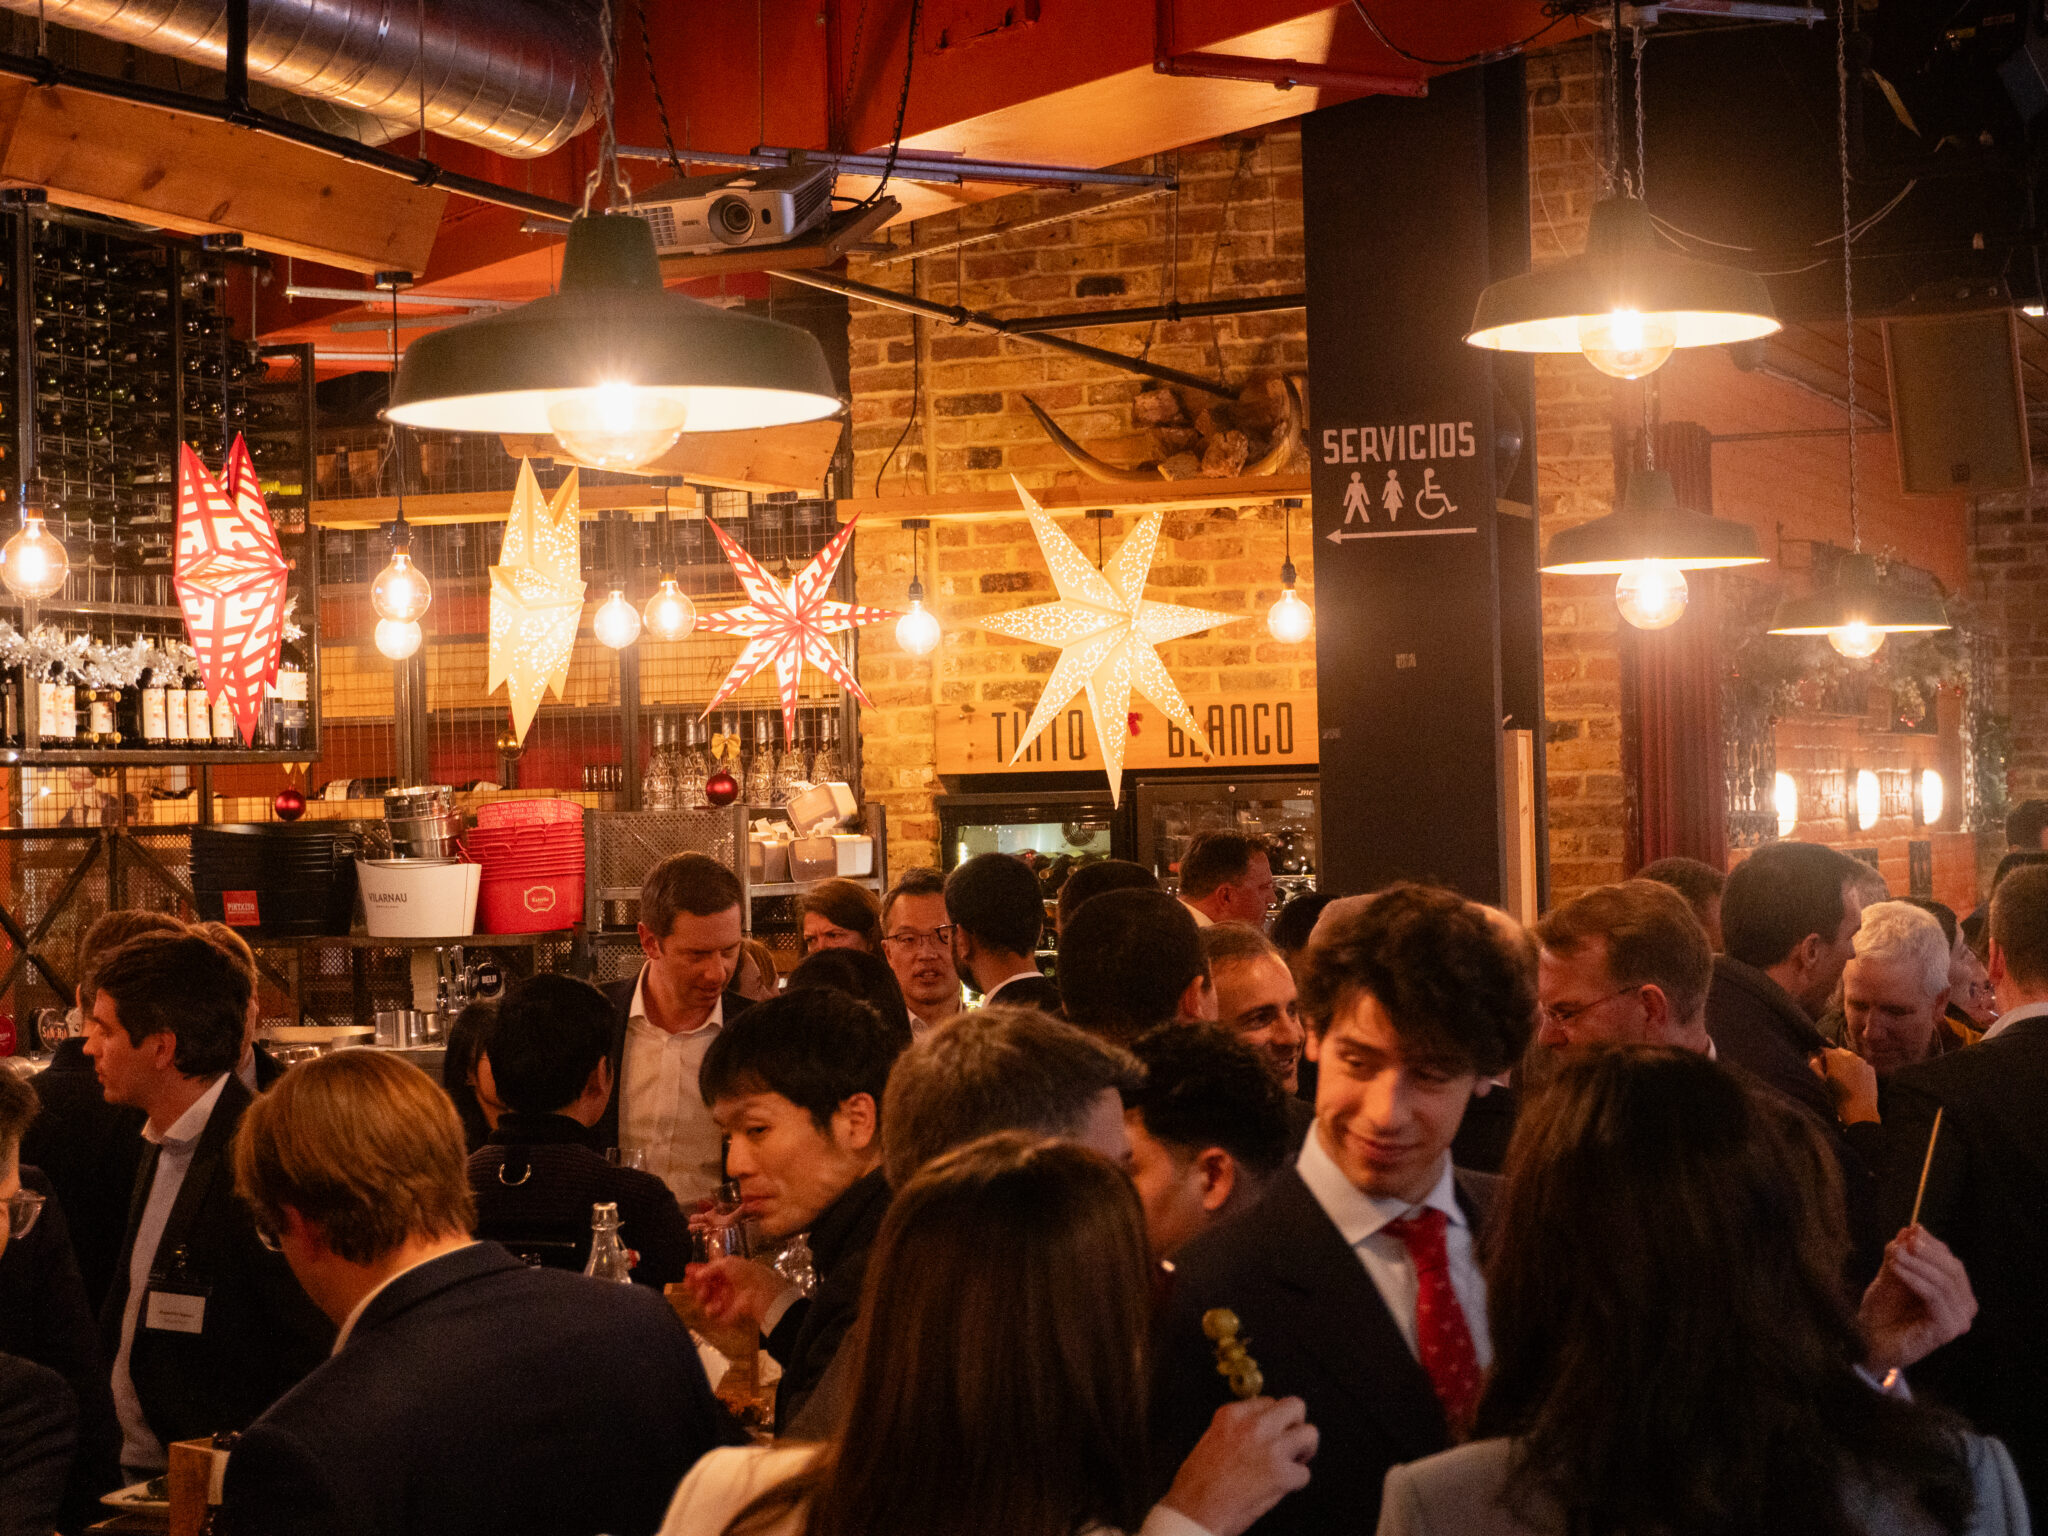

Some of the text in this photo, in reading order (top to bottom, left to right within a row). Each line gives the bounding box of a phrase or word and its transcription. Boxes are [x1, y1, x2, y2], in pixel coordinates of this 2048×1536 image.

[1323, 422, 1475, 464] SERVICIOS
[1168, 702, 1294, 757] BLANCO
[368, 893, 407, 903] VILARNAU
